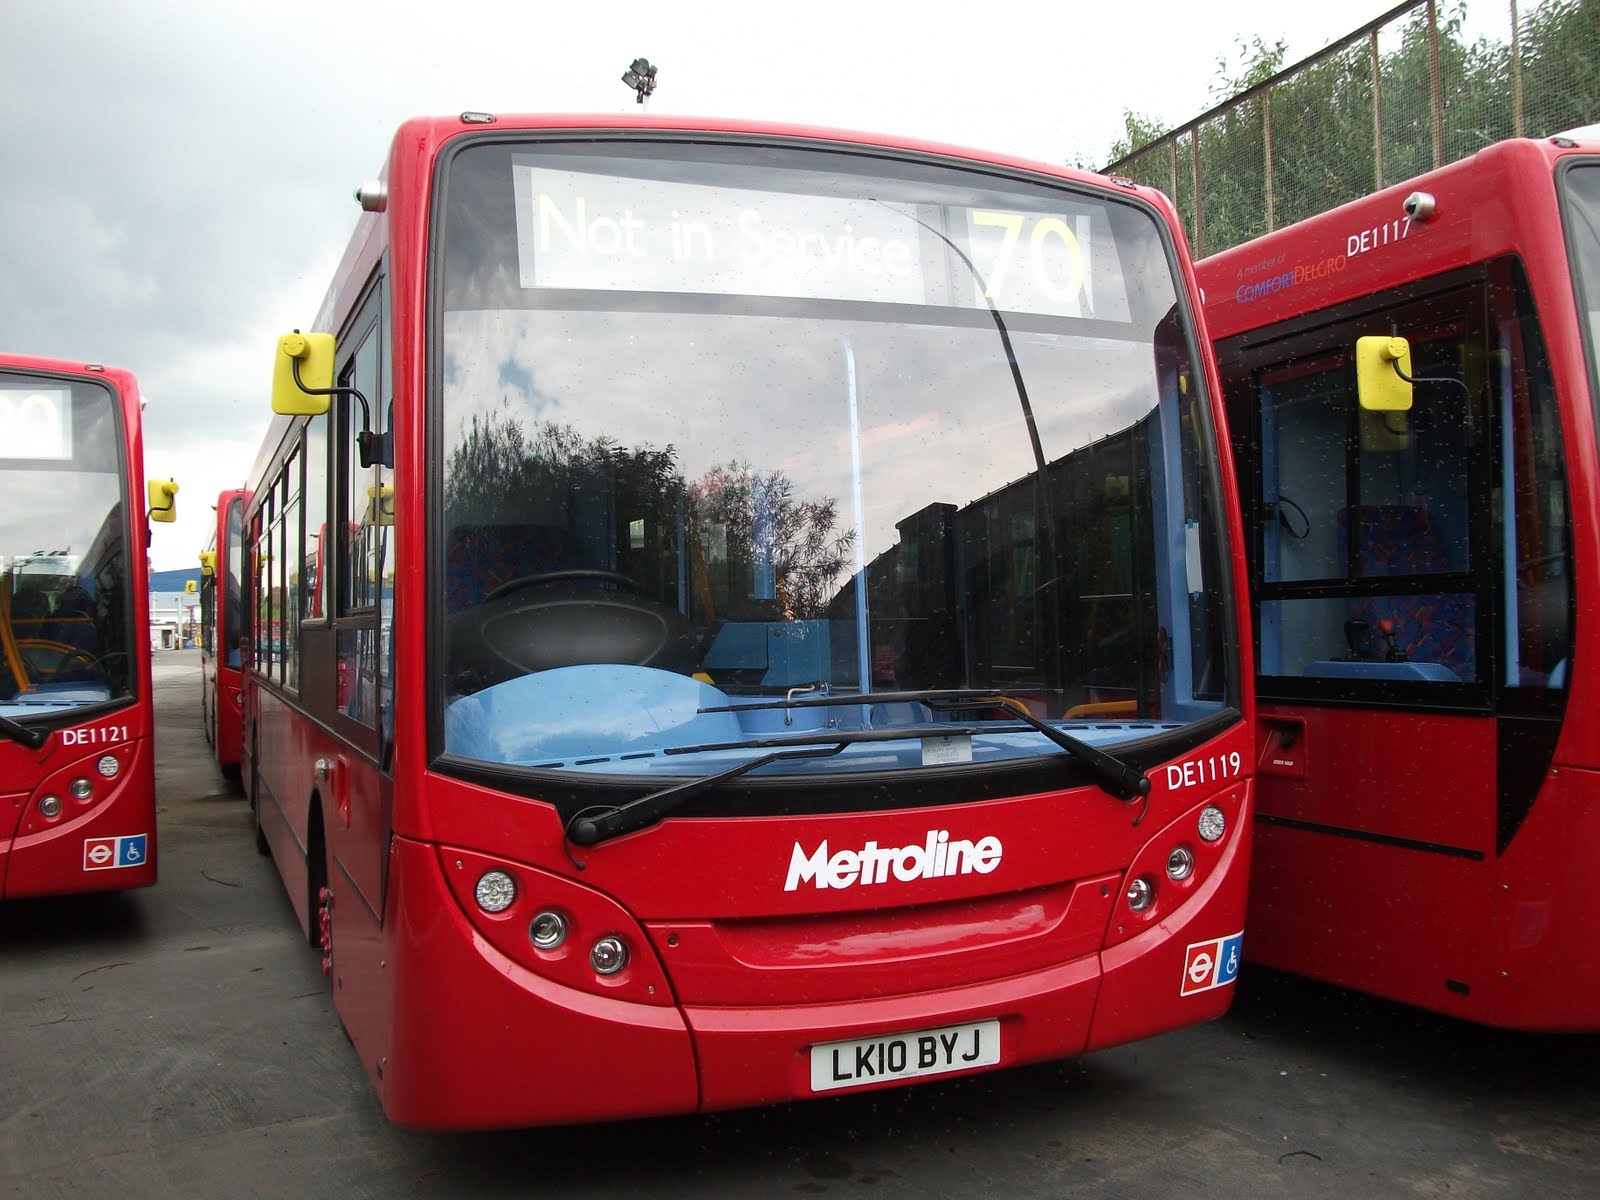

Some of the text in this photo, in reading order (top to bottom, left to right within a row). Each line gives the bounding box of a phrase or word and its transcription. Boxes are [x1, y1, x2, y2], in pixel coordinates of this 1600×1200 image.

[536, 192, 916, 278] Not in Service
[971, 210, 1085, 302] 70
[1347, 216, 1411, 257] DE1117
[63, 727, 128, 745] DE1121
[1167, 752, 1241, 790] DE1119
[784, 830, 1003, 892] Metroline
[832, 1029, 980, 1082] LK10 BYJ
